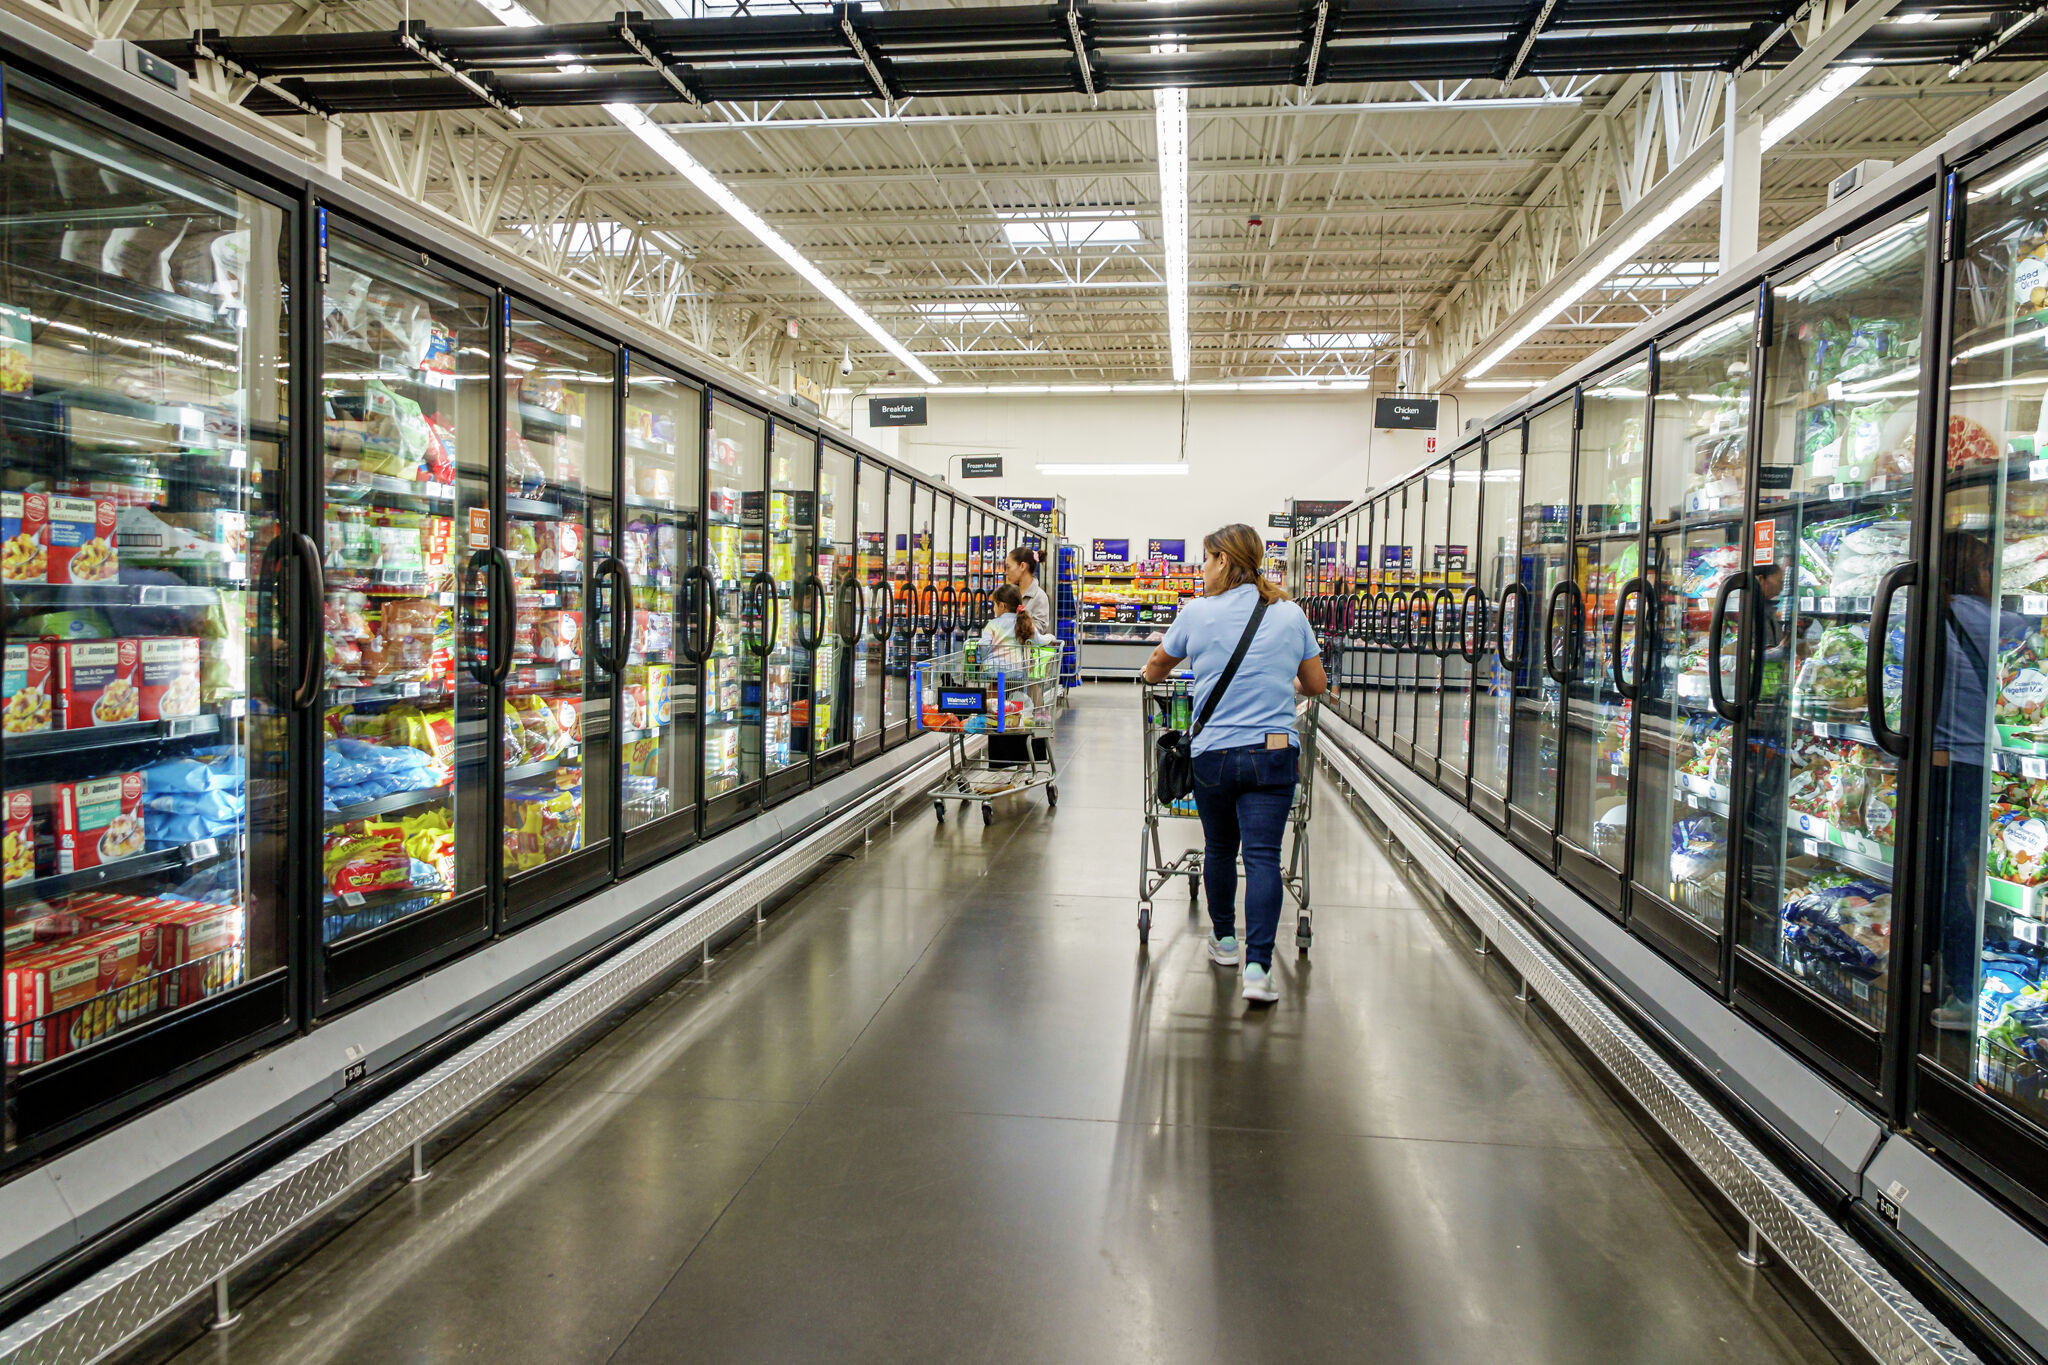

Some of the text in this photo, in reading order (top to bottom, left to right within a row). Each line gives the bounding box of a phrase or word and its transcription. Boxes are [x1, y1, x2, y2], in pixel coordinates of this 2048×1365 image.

[2021, 279, 2040, 290] Okra
[882, 404, 914, 413] Breakfast
[1394, 406, 1419, 414] Chicken
[1009, 501, 1024, 509] Low
[474, 517, 486, 528] WIC
[1759, 528, 1770, 541] WIC
[632, 740, 653, 763] Eggo
